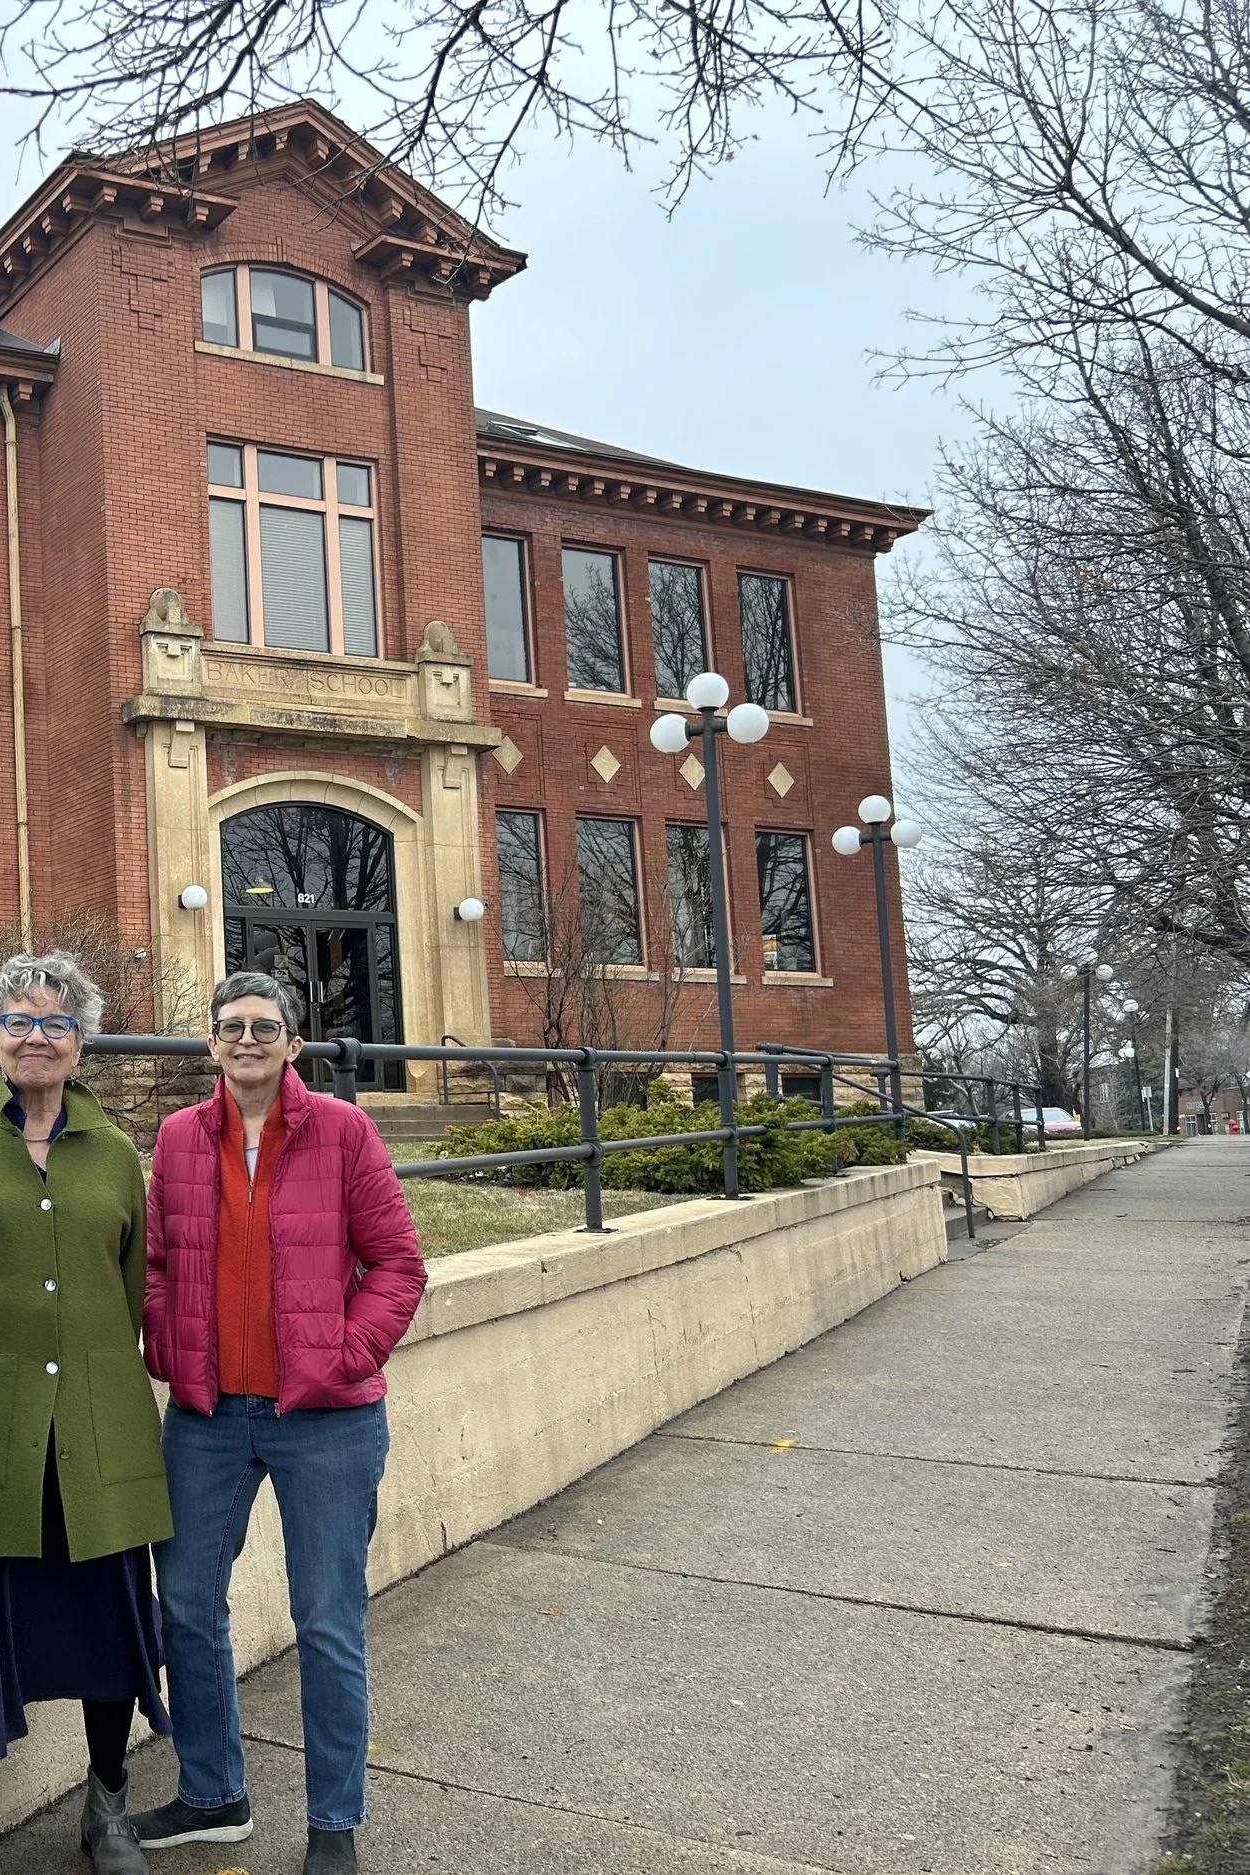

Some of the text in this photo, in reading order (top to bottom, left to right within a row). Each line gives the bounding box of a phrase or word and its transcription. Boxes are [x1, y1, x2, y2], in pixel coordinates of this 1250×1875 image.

[207, 662, 405, 699] BAKER SCHOOL
[297, 893, 315, 904] 821
